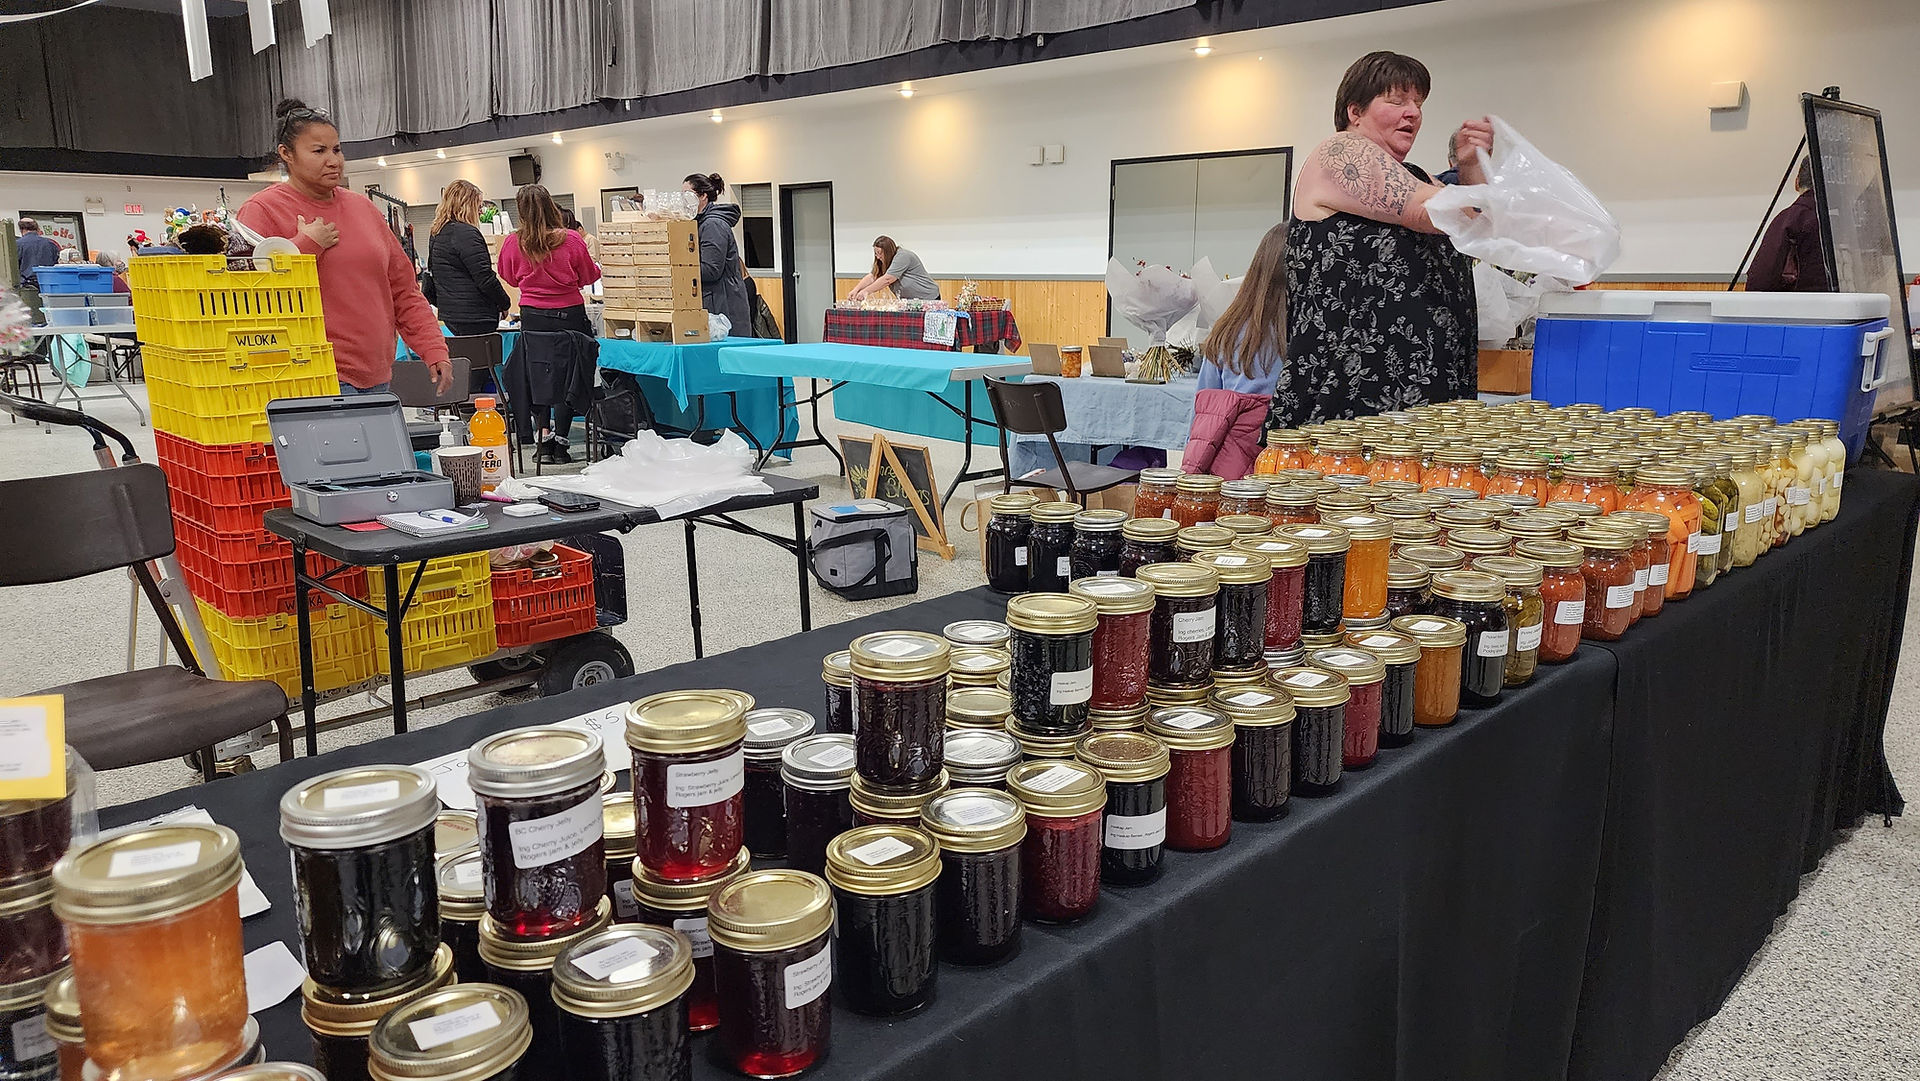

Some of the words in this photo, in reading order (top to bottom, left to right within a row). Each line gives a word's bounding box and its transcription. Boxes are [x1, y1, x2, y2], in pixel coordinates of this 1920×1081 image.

[235, 334, 278, 347] WLOKA
[485, 450, 494, 460] G
[284, 595, 324, 611] WKA
[515, 827, 527, 836] BC
[528, 823, 555, 834] Cherry
[532, 839, 558, 850] Cherry
[520, 851, 548, 861] Rogers
